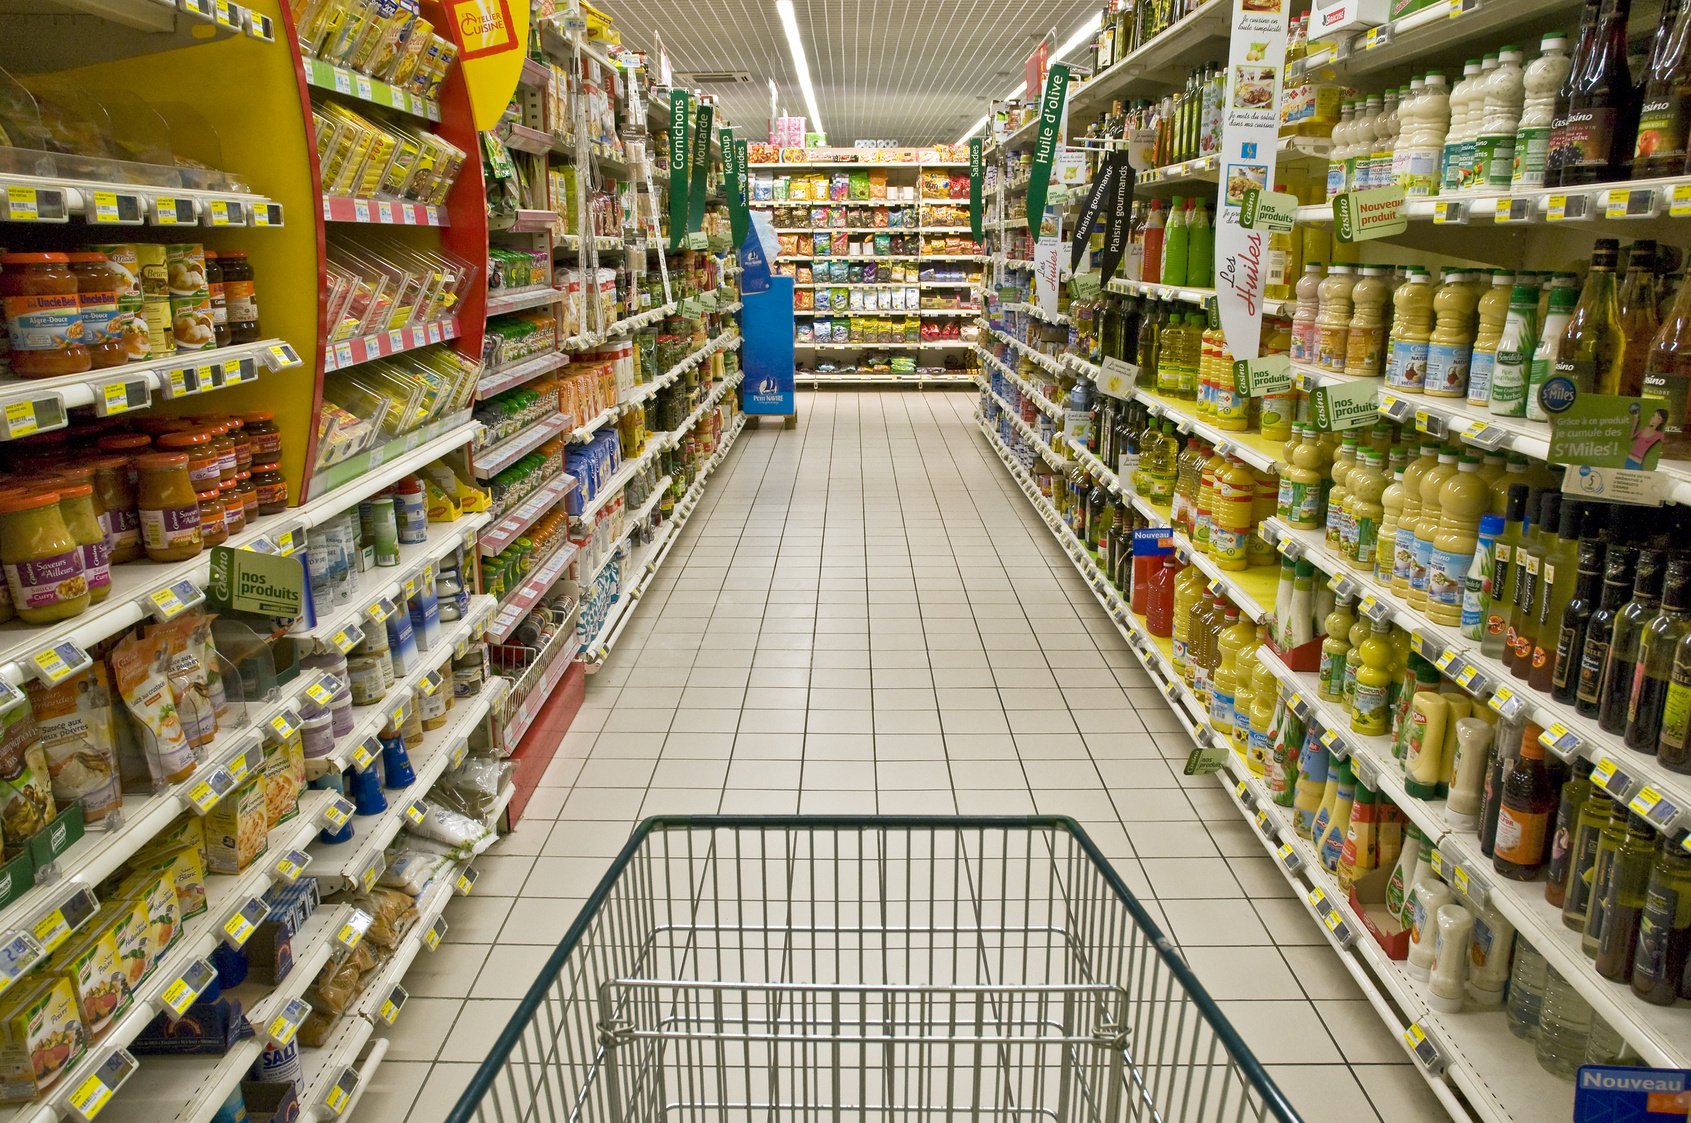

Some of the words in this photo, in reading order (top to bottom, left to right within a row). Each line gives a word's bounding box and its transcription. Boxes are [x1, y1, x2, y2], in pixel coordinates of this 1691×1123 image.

[1641, 100, 1669, 114] asino
[1036, 128, 1054, 164] Huile
[1046, 74, 1063, 124] d'olive
[672, 99, 684, 171] Cornichons
[695, 113, 709, 167] Moutarde
[723, 135, 733, 174] Ketchup
[970, 144, 979, 178] Salades
[1115, 165, 1128, 217] gourmands
[1244, 191, 1256, 225] Casino
[1260, 204, 1276, 213] nos
[1359, 199, 1404, 213] Nouveau
[1076, 209, 1094, 240] Plaisirs
[1259, 211, 1294, 223] produits
[1340, 198, 1353, 239] Casino
[1361, 210, 1397, 227] produit
[1110, 219, 1122, 253] Plaisirs
[1220, 256, 1237, 289] Les
[1236, 232, 1263, 317] Huiles
[1239, 363, 1248, 395] Casino
[1253, 370, 1269, 379] nos
[1254, 374, 1290, 387] produits
[1316, 391, 1329, 429] Casino
[1334, 398, 1353, 409] nos
[1335, 402, 1379, 419] produits
[1557, 416, 1580, 426] Grâce
[1582, 415, 1588, 424] à
[1589, 417, 1599, 425] ce
[1599, 416, 1630, 426] produit
[1555, 429, 1565, 440] je
[1567, 428, 1604, 439] cumule
[1605, 427, 1622, 437] des
[1134, 531, 1170, 539] Nouveau
[36, 559, 67, 571] Saveurs
[215, 551, 230, 602] Casino
[241, 571, 266, 585] nos
[33, 592, 55, 601] Curry
[241, 583, 299, 601] produits
[42, 721, 67, 734] Sauce
[67, 718, 82, 728] aux
[60, 724, 89, 738] poivres
[262, 1040, 295, 1067] SALT
[1583, 1071, 1681, 1091] Nouveau
